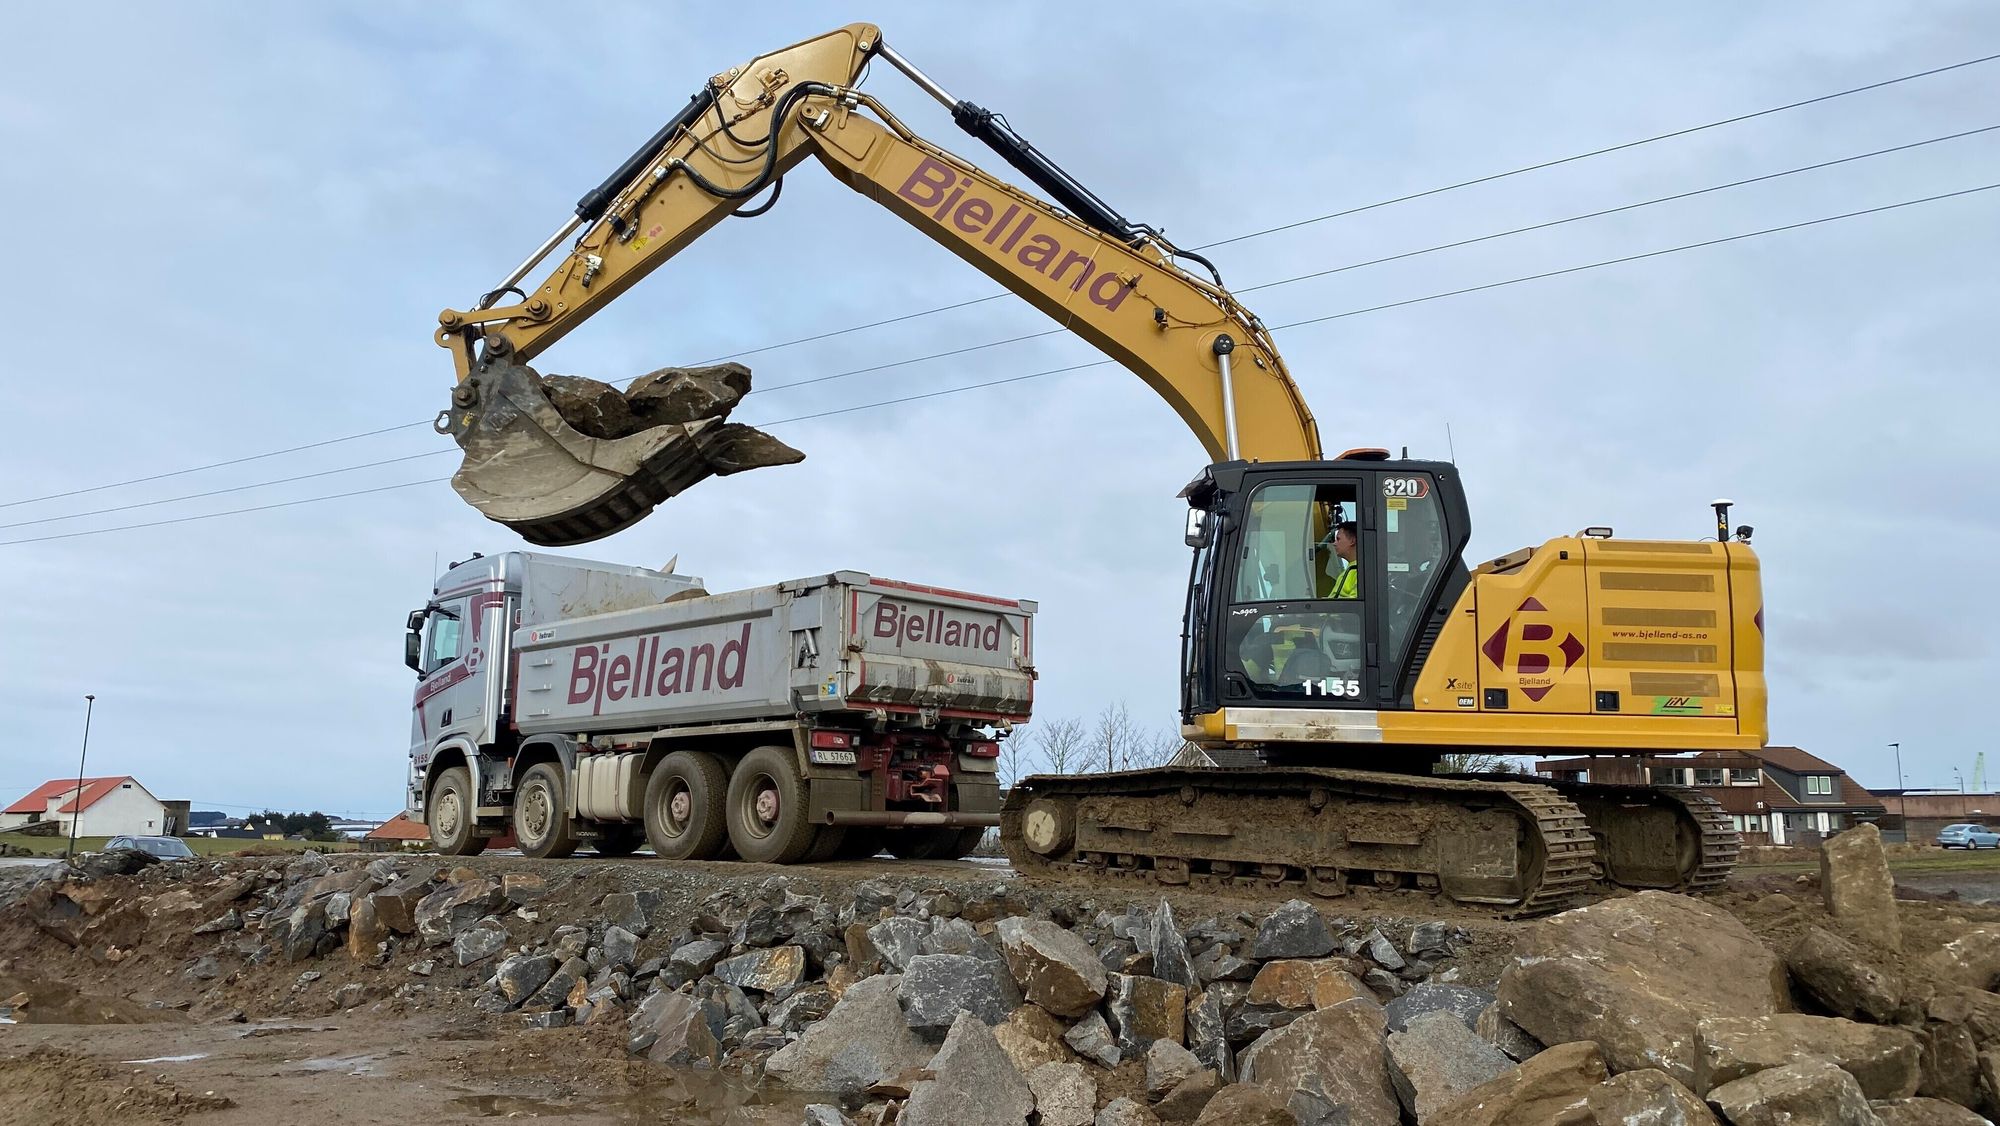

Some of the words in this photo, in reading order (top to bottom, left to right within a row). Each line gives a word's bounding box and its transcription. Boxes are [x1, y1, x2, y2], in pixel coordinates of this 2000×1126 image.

[897, 156, 1143, 312] Bjelland
[1384, 479, 1418, 496] 320
[873, 602, 1002, 652] Bjelland
[1612, 630, 1708, 640] www.bjelland-as.no
[567, 622, 752, 716] Bjelland
[1302, 679, 1360, 697] 1155
[1519, 677, 1551, 686] Bjelland
[1458, 698, 1474, 706] OEM
[818, 751, 829, 761] RL
[831, 752, 853, 761] 57662
